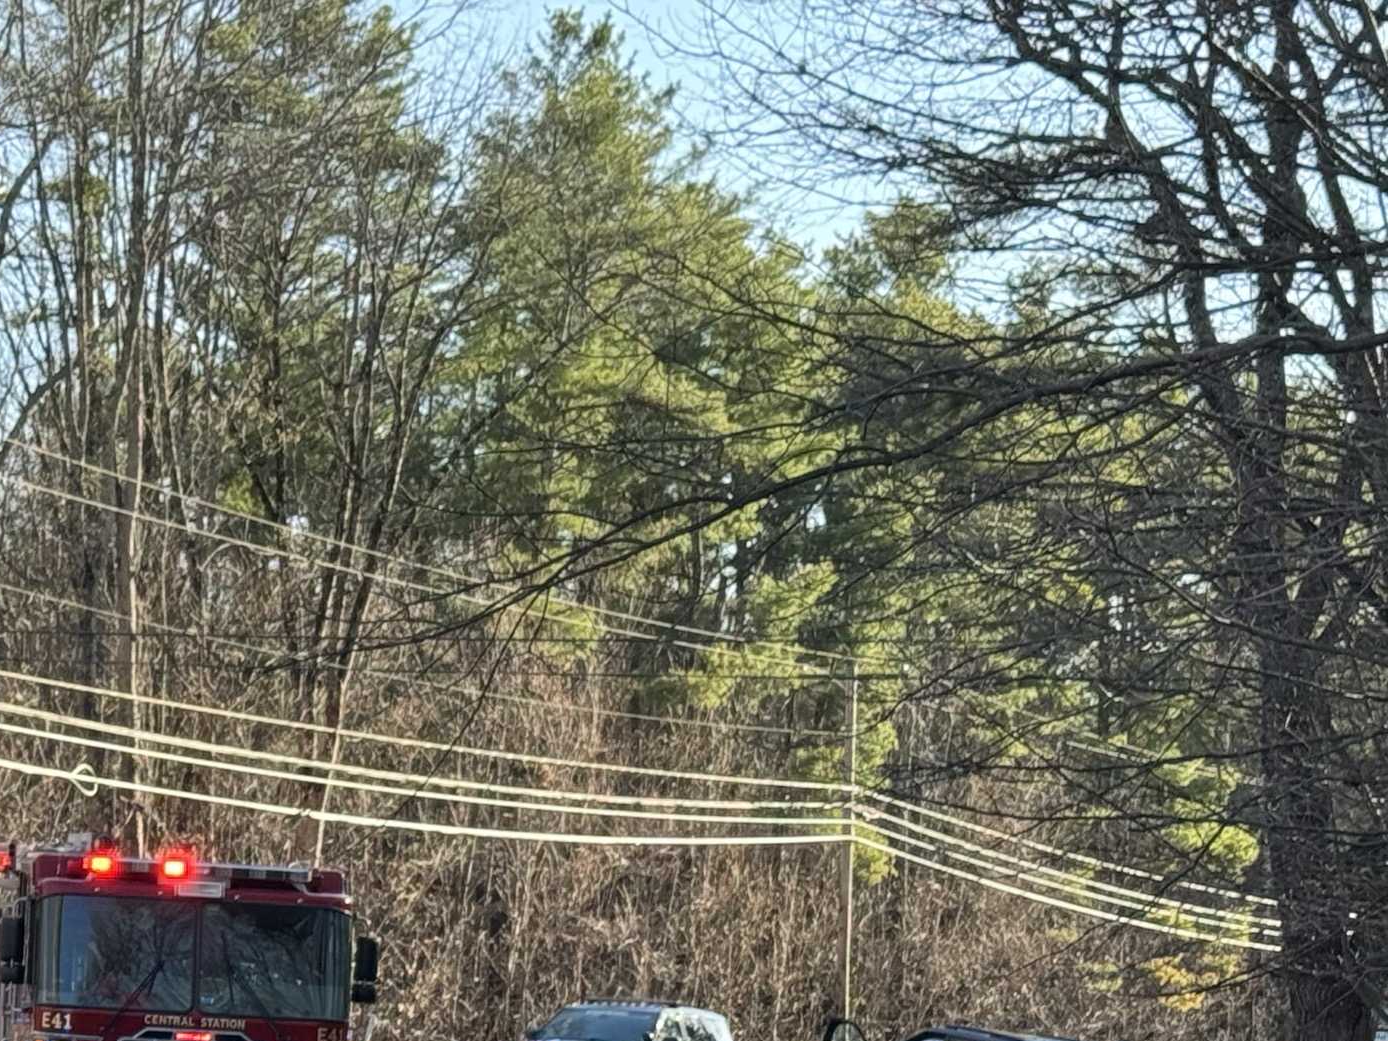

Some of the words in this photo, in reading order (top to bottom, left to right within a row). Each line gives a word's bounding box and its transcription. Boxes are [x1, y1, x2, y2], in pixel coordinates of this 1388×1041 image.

[41, 1012, 73, 1030] E41
[144, 1014, 194, 1027] CENTRAL
[201, 1017, 246, 1030] STATION
